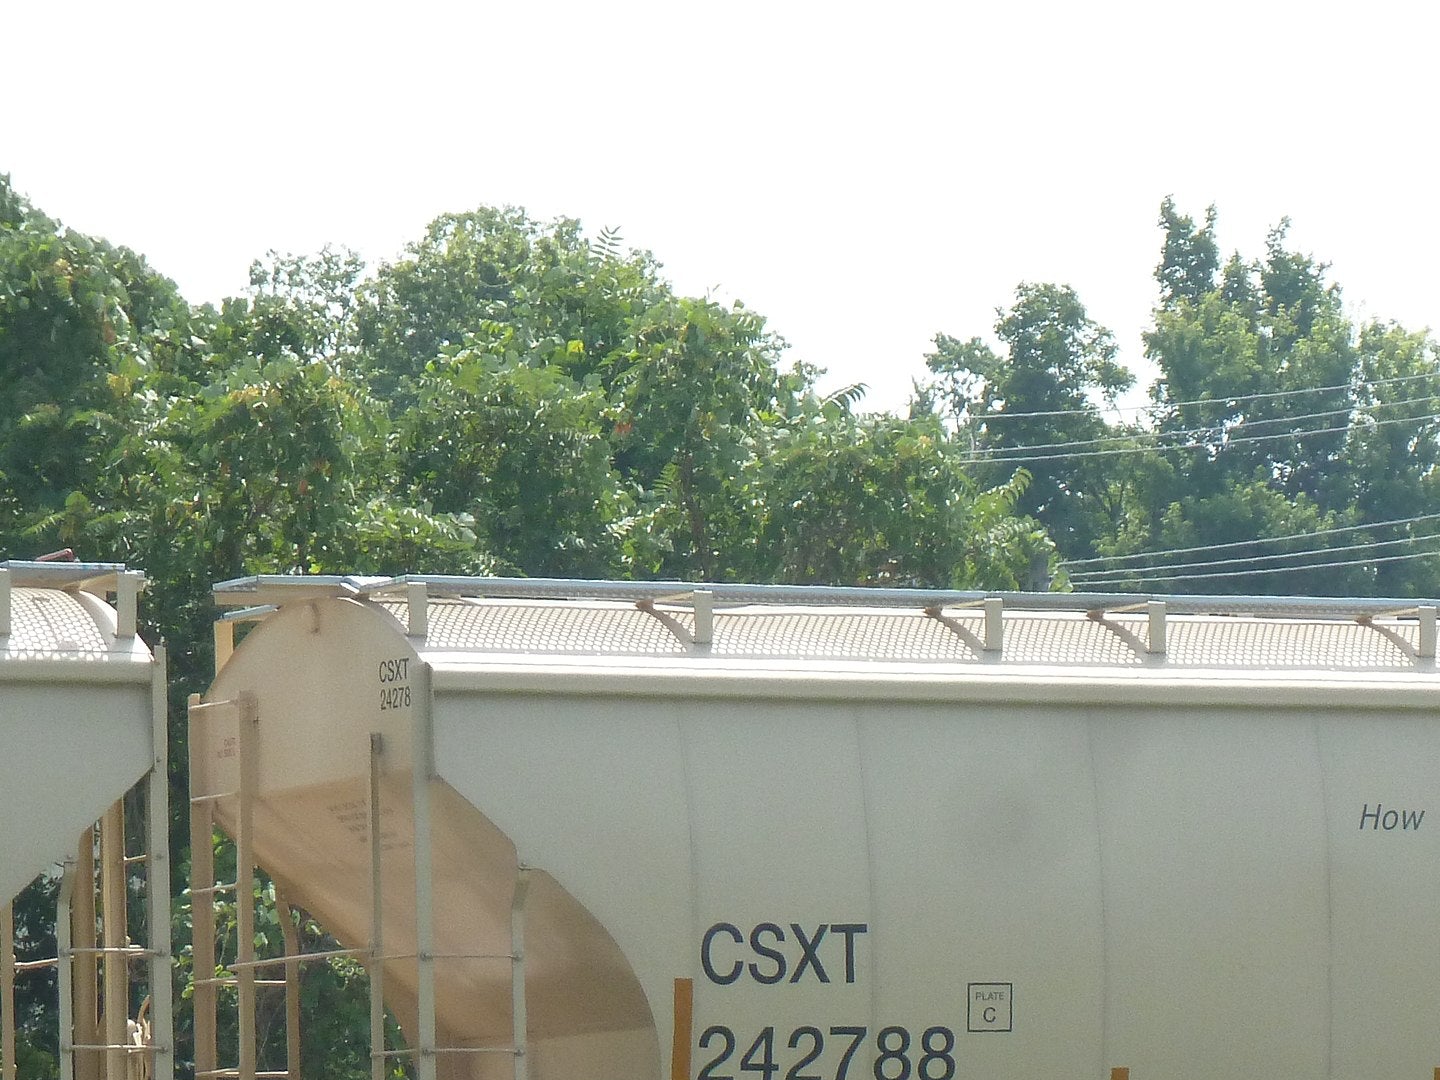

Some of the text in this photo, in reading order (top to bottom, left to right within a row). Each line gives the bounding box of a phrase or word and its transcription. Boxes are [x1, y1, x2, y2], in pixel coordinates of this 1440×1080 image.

[379, 657, 409, 683] CSXT
[380, 685, 411, 710] 24278
[1359, 803, 1425, 831] How
[701, 922, 868, 986] CSXT
[975, 991, 1005, 1001] PLATE
[983, 1006, 996, 1023] C
